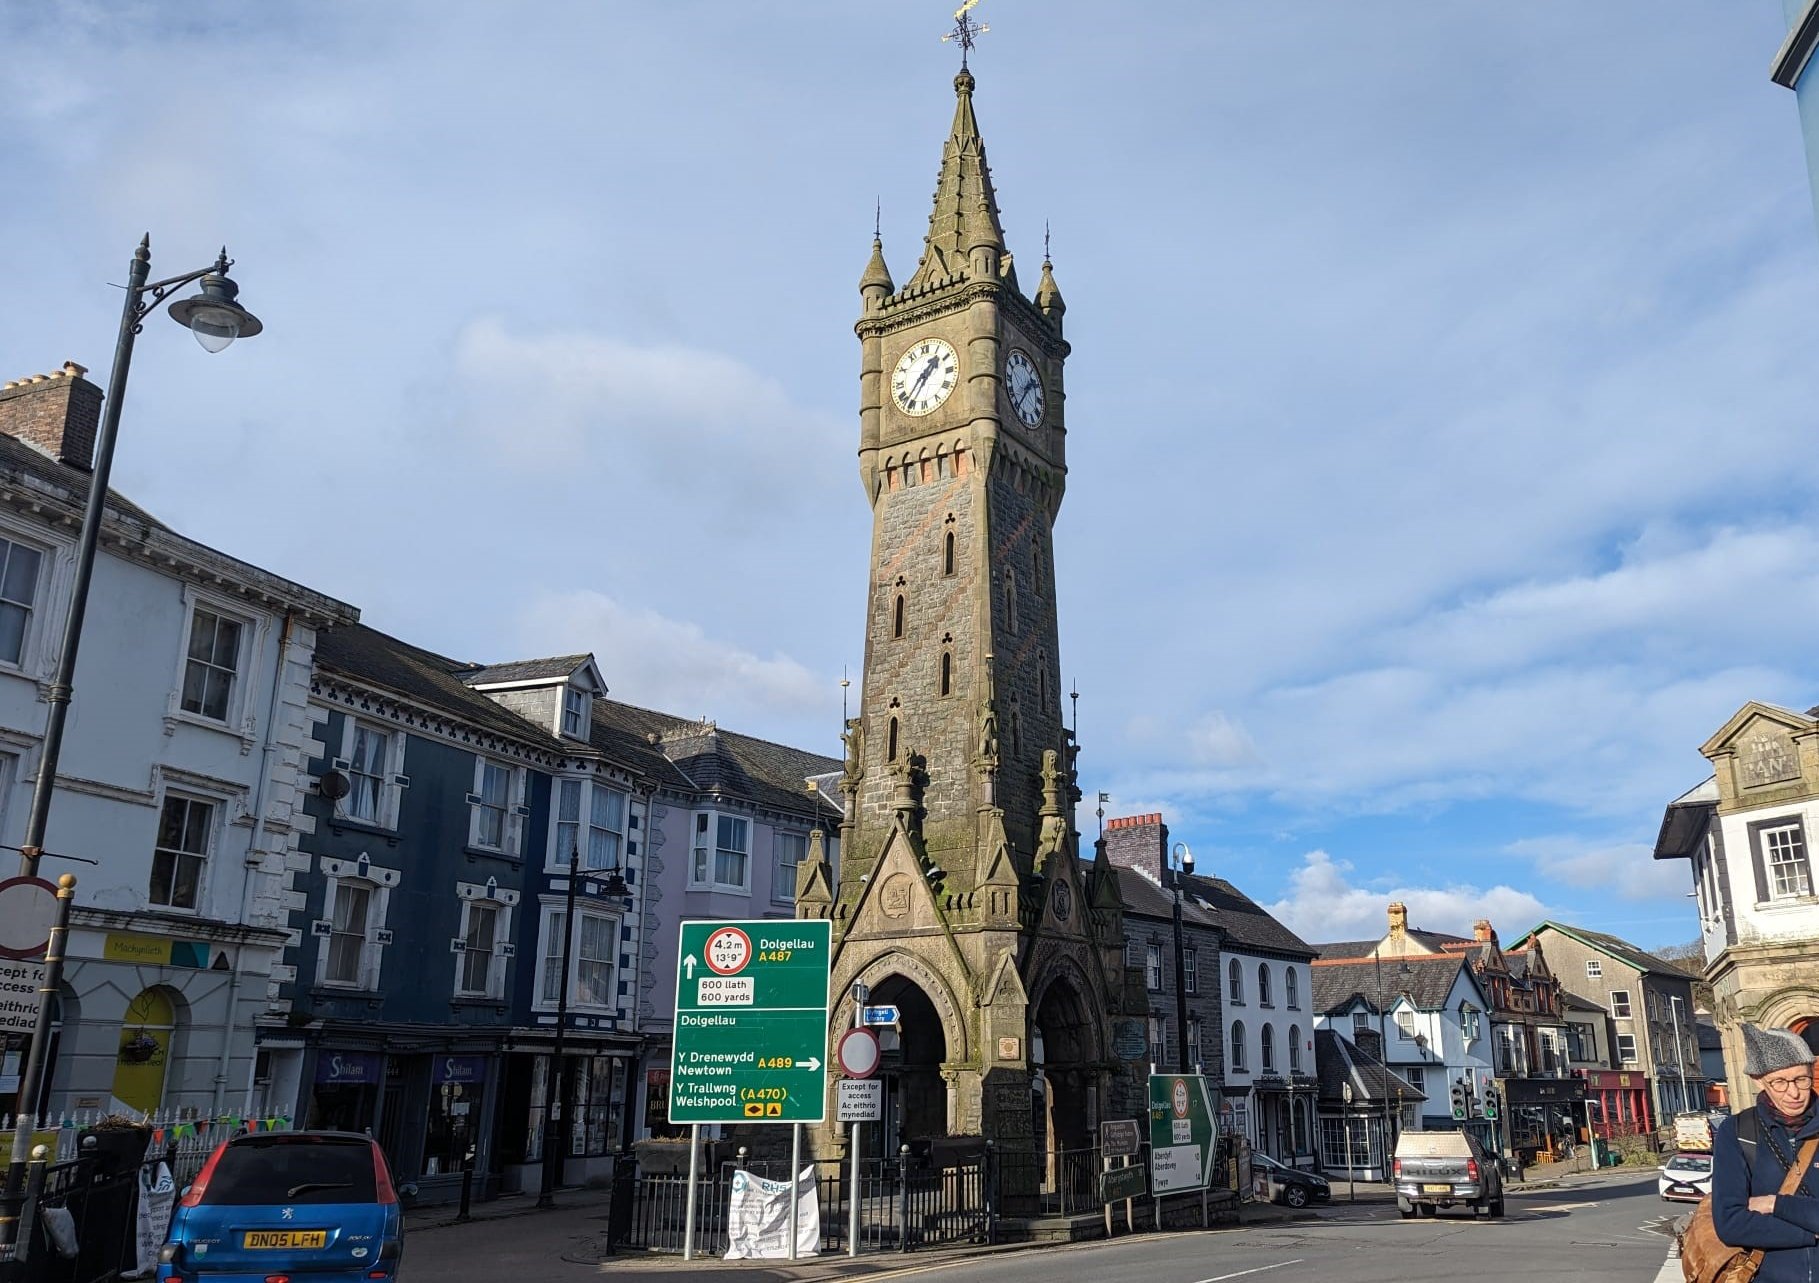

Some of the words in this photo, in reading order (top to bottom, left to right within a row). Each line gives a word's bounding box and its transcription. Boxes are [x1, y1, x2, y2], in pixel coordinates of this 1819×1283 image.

[760, 939, 814, 950] Dolgellau
[759, 951, 791, 961] A487
[702, 980, 722, 989] 600
[725, 980, 746, 989] llath
[701, 993, 721, 1001] 600
[724, 992, 750, 1003] yards
[681, 1015, 736, 1027] Dolgellau
[678, 1052, 686, 1062] Y
[690, 1051, 754, 1064] Drenewydd
[758, 1057, 792, 1068] A489
[678, 1065, 732, 1075] Newtown
[676, 1082, 684, 1093] Y
[688, 1082, 736, 1095] Trallwng
[842, 1083, 866, 1091] Except
[740, 1087, 787, 1101] (A470)
[676, 1096, 737, 1108] Welshpool
[842, 1101, 851, 1109] Ac
[841, 1111, 875, 1119] mynediad
[1155, 1162, 1177, 1171] Aberdovey
[292, 1233, 320, 1246] LFH
